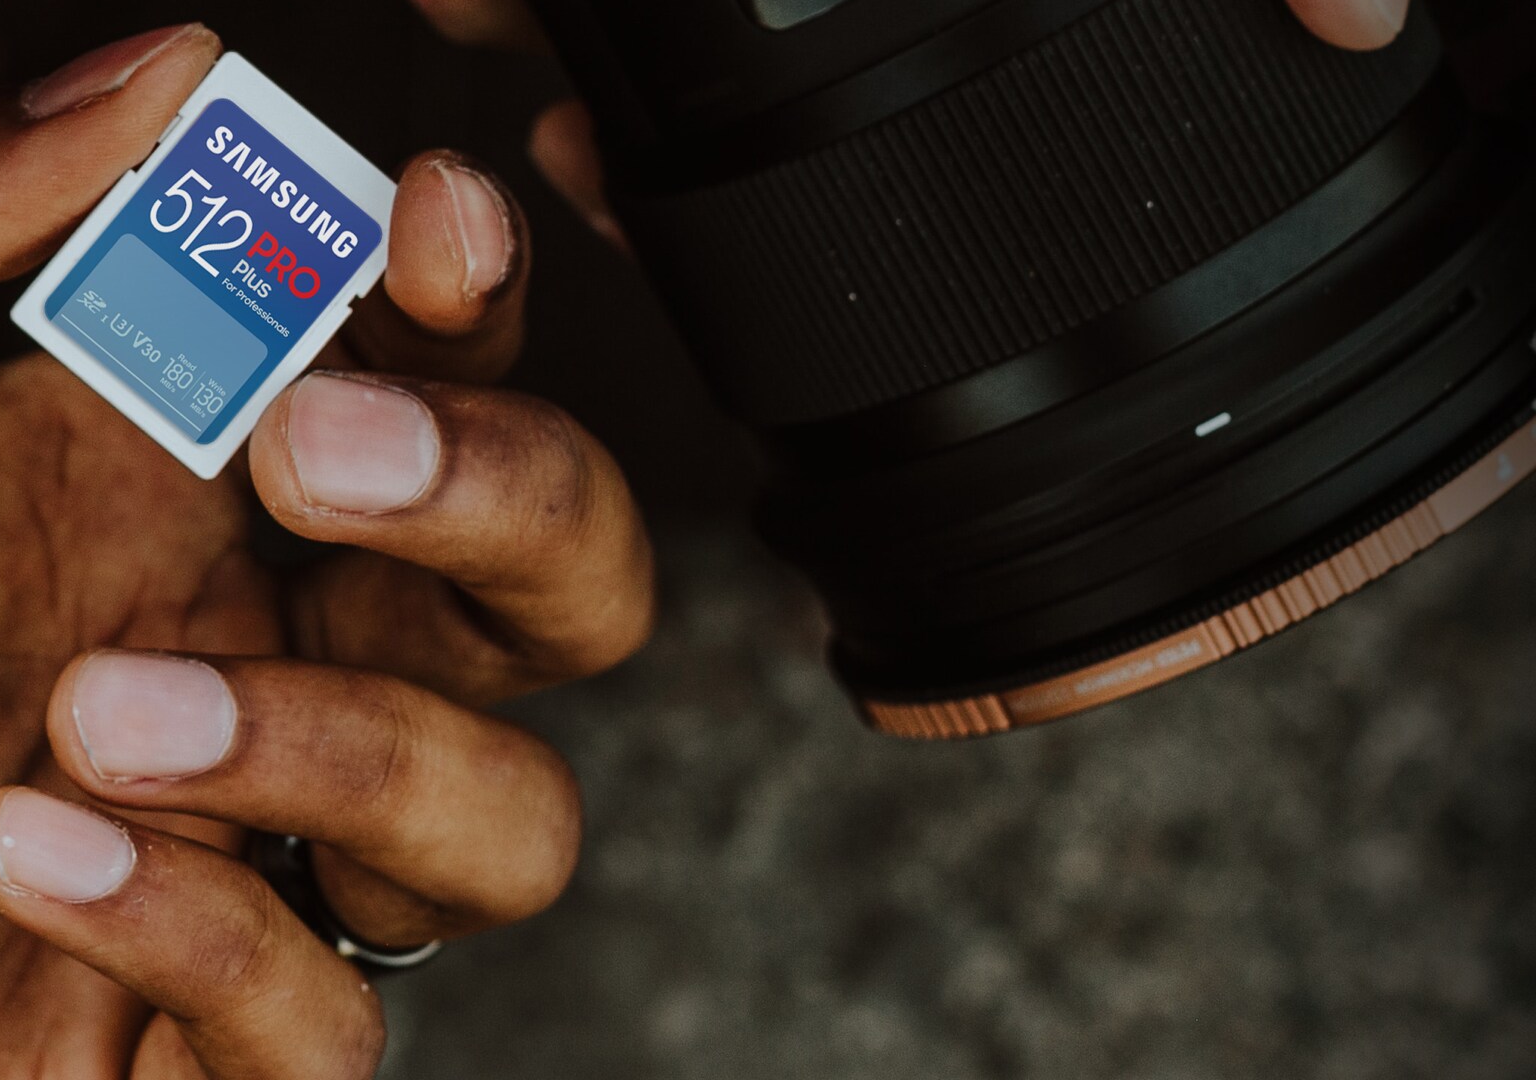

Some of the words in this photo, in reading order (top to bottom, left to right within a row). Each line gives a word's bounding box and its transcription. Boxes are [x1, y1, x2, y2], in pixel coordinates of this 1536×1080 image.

[206, 126, 358, 258] SAMSUNG
[149, 169, 254, 277] 512
[247, 231, 321, 299] PRO
[232, 259, 272, 299] Plus
[221, 277, 238, 293] For
[236, 290, 291, 338] Professionals
[133, 331, 162, 363] V30
[177, 353, 197, 372] Read
[160, 377, 176, 393] MB/s
[162, 357, 194, 390] 180
[208, 378, 227, 397] Write
[190, 402, 206, 419] MB/s
[193, 383, 224, 415] 130
